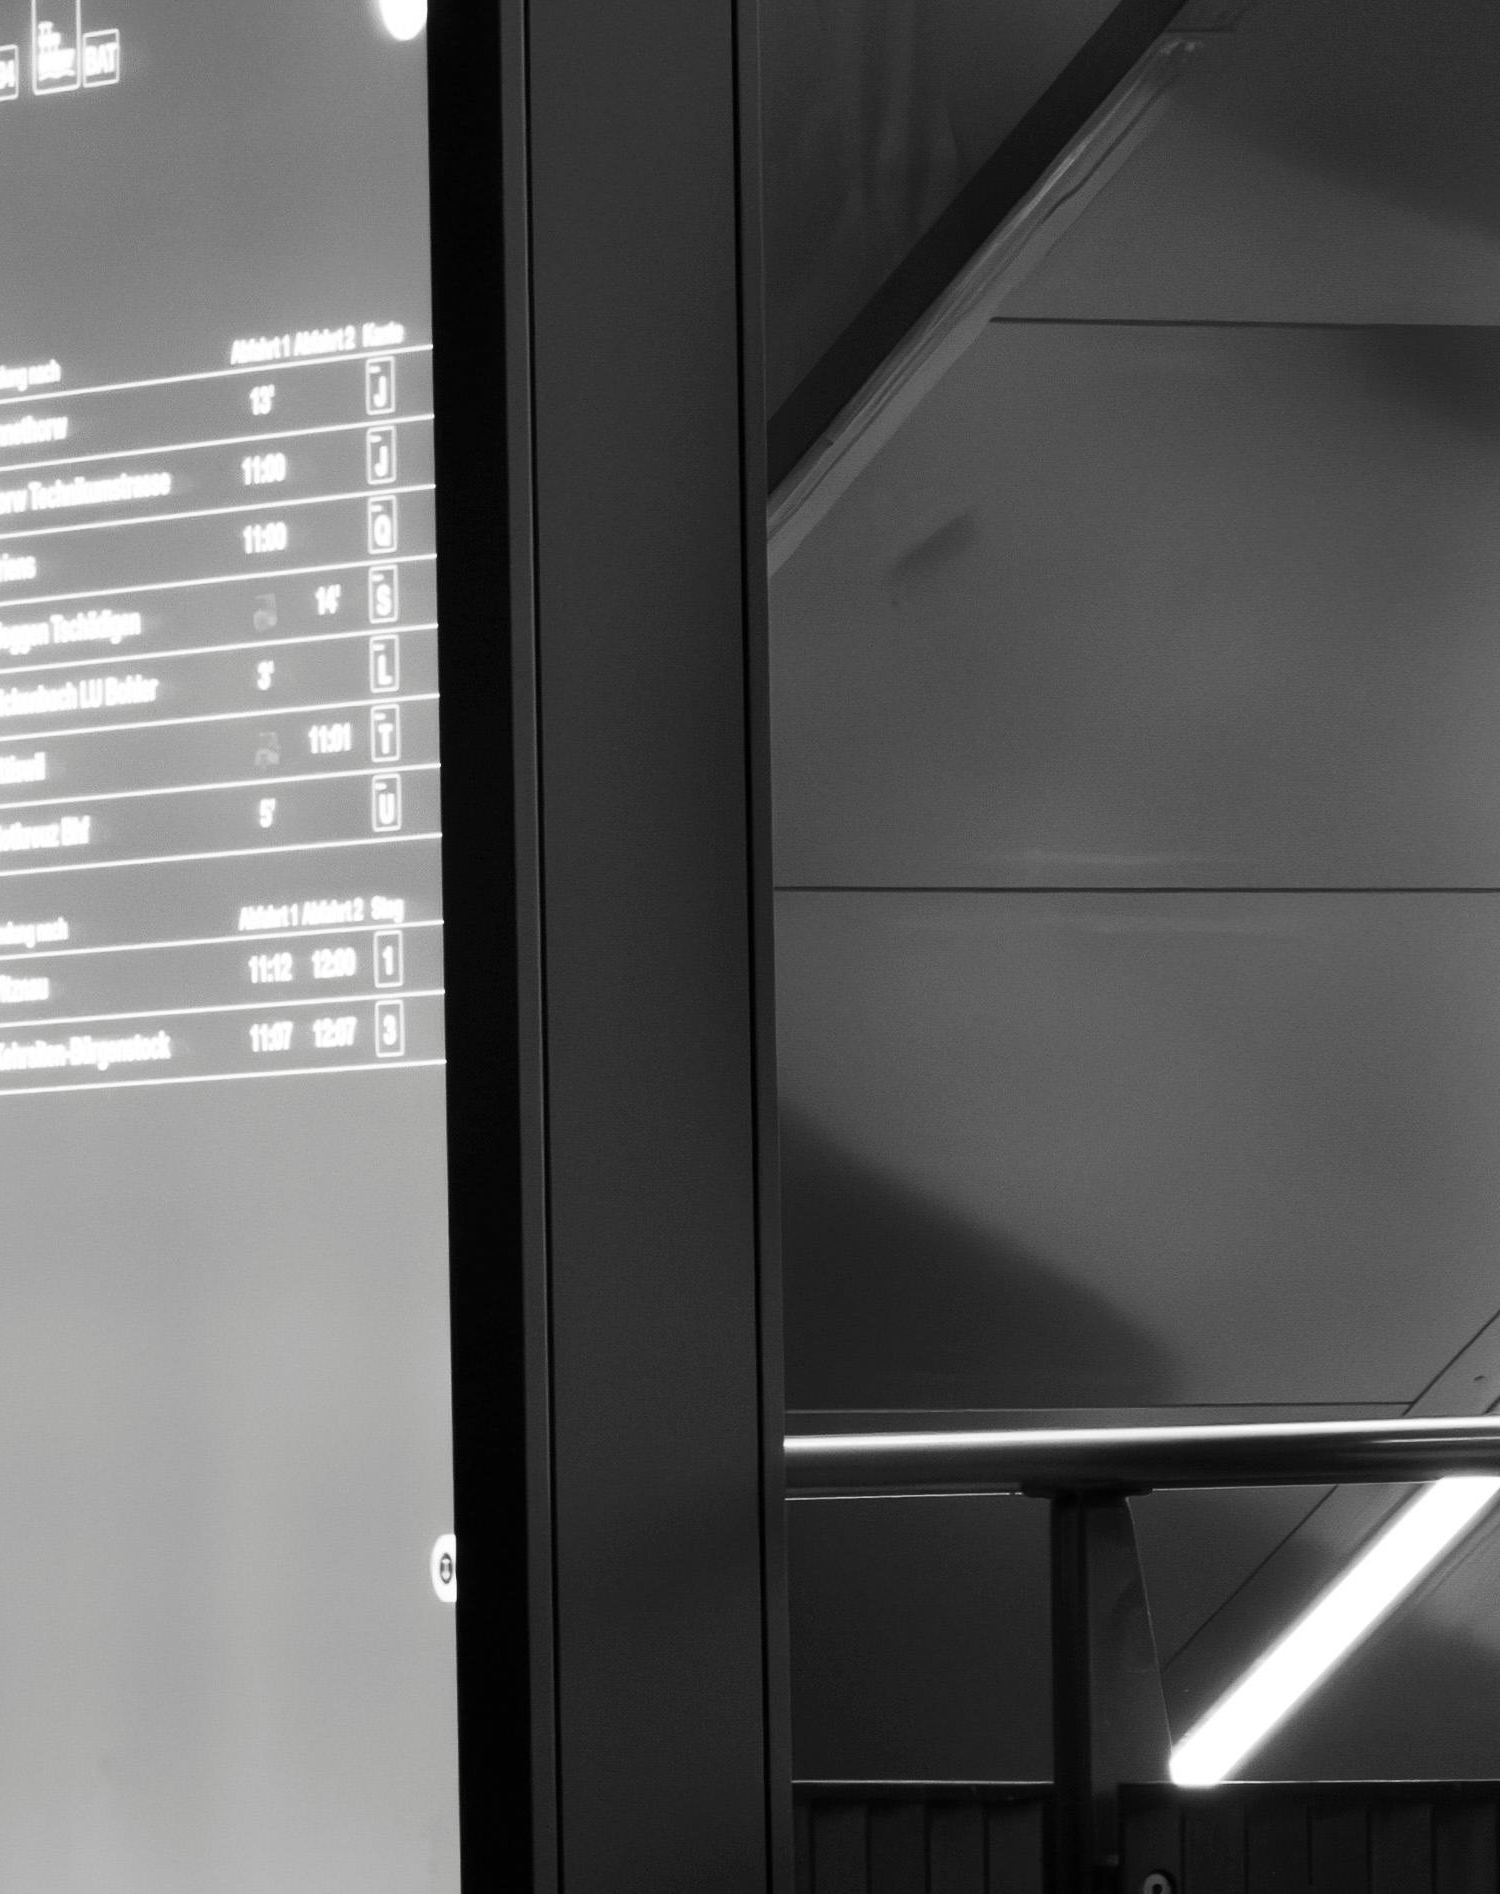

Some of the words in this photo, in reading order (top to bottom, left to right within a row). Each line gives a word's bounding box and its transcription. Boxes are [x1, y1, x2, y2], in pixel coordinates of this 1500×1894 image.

[373, 375, 387, 408] J
[374, 445, 388, 477] J
[373, 514, 392, 547] Q
[375, 583, 392, 616] S
[377, 654, 393, 686] L
[377, 723, 394, 755] T
[378, 793, 396, 825] U
[382, 945, 394, 976] 1
[382, 1014, 398, 1046] 3
